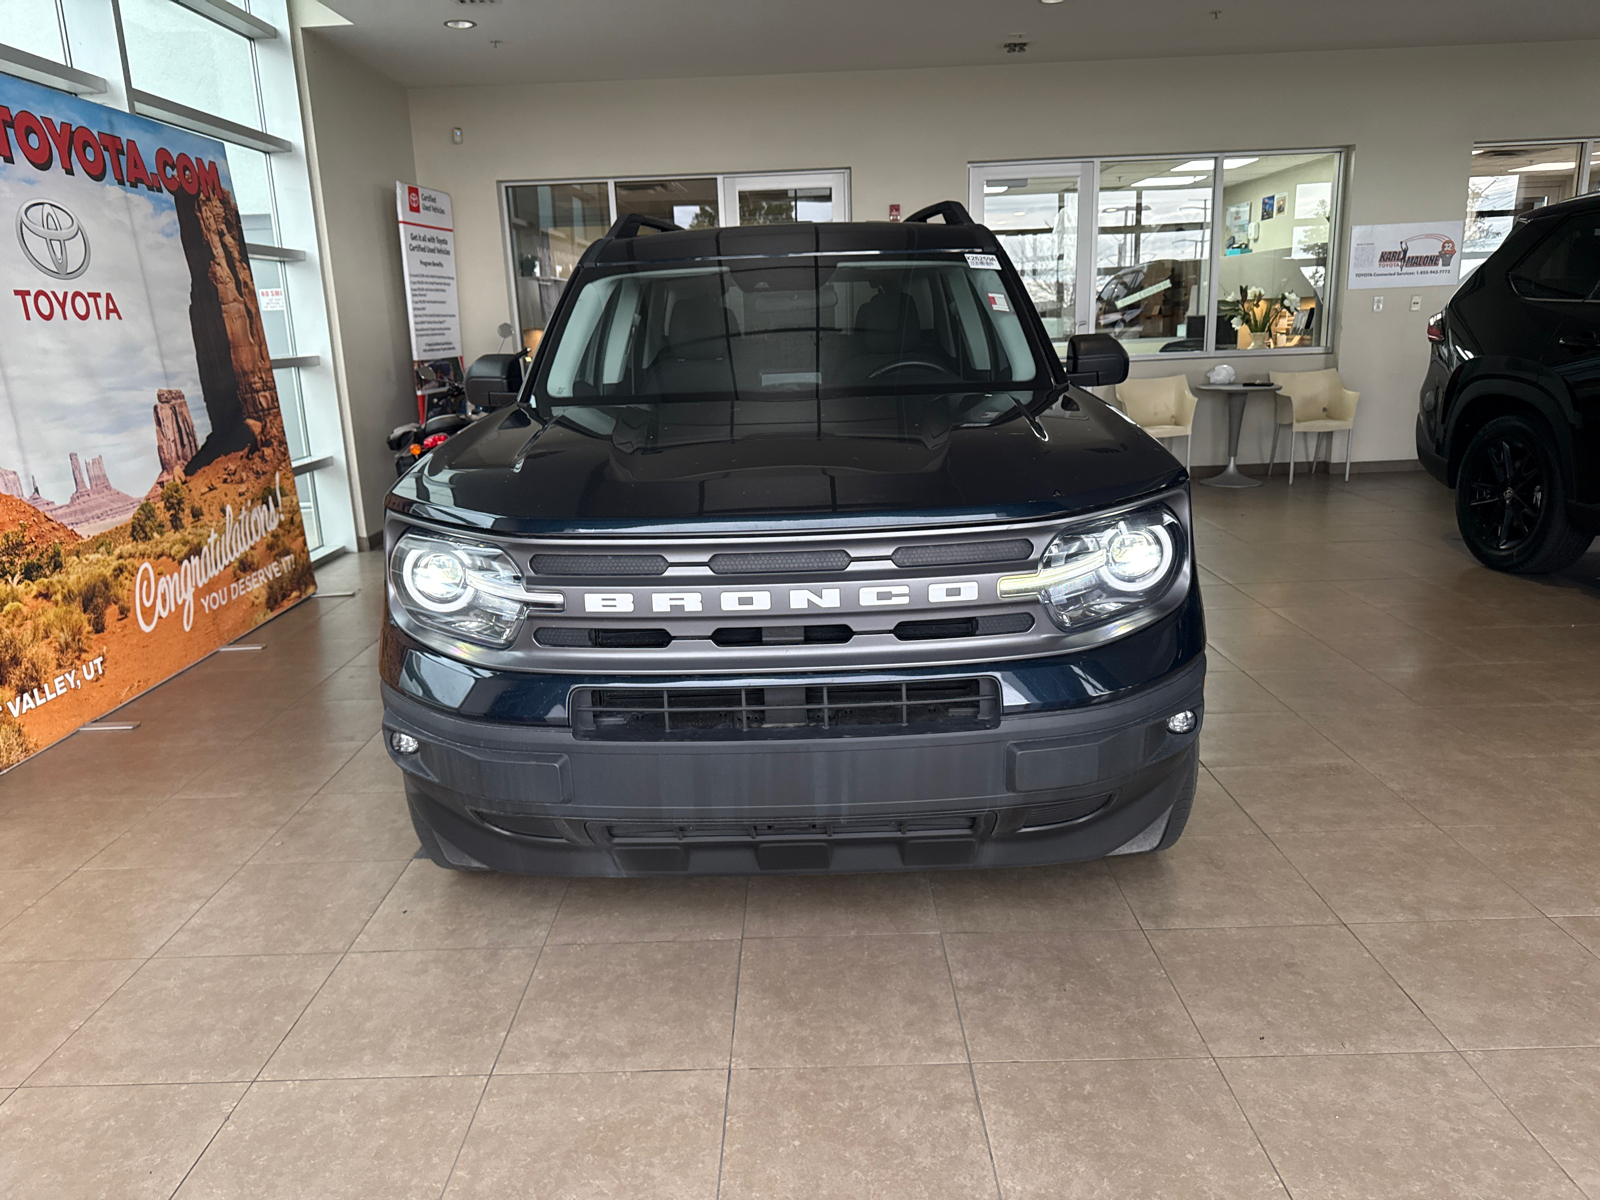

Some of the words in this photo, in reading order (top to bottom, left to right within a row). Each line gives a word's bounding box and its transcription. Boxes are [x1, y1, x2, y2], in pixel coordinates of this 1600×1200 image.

[1379, 251, 1403, 262] KARL
[1406, 255, 1440, 267] MALONE
[13, 289, 123, 321] TOYOTA
[135, 470, 285, 633] Congratulations!
[201, 586, 228, 614] YOU
[230, 561, 282, 600] DESERVE
[281, 553, 296, 573] IT!
[584, 581, 978, 613] BRONCO
[7, 669, 81, 718] VALLEY,
[82, 656, 103, 680] UT
